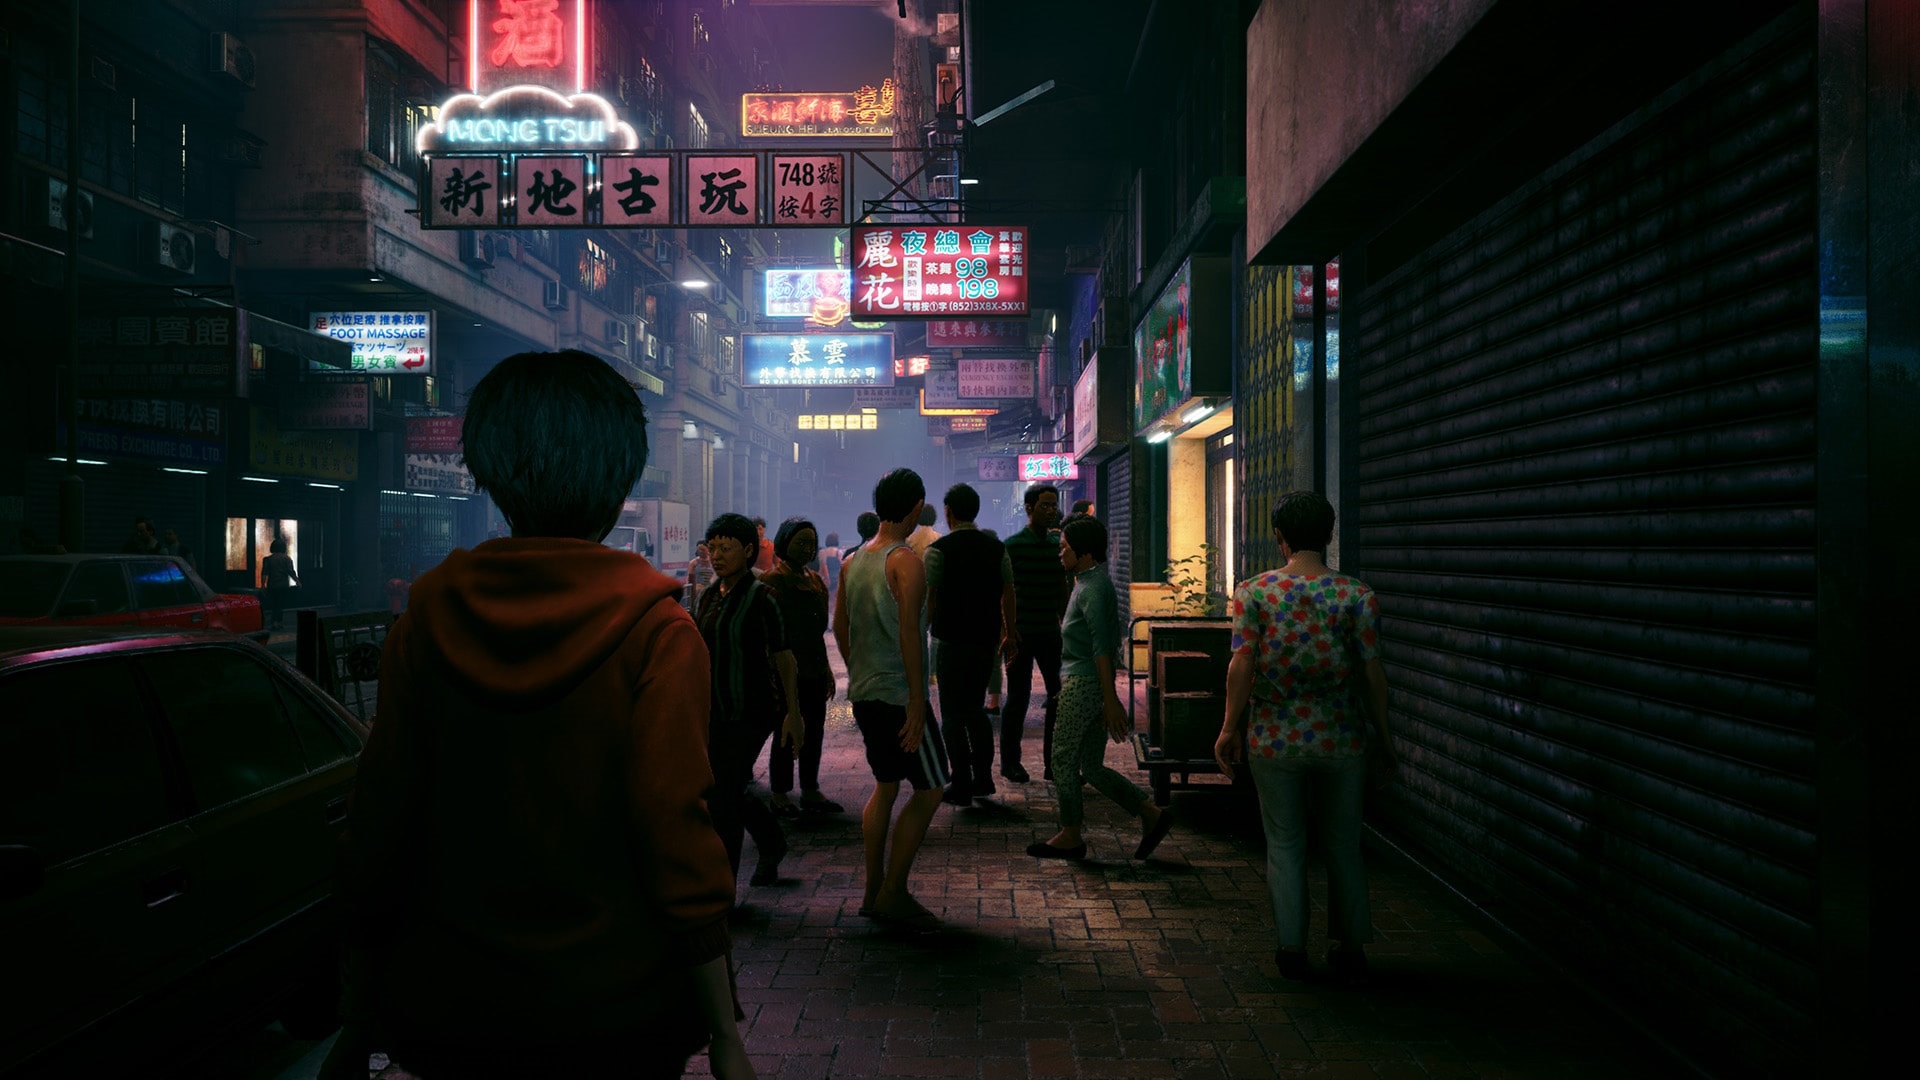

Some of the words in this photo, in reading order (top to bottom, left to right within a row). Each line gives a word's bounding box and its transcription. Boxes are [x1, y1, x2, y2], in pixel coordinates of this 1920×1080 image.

[448, 119, 539, 142] MONG
[544, 119, 605, 142] TSUI
[746, 125, 795, 134] SHEUNG
[798, 125, 818, 134] HEI
[778, 162, 840, 187] 748號
[440, 167, 749, 217] 新地古玩
[778, 191, 840, 219] 按4字
[901, 229, 994, 256] 夜總會
[857, 230, 899, 312] 麗花
[925, 262, 952, 275] 茶舞
[956, 257, 989, 279] 98
[957, 278, 999, 300] 198
[330, 328, 363, 339] FOOT
[367, 328, 425, 339] MASSAGE
